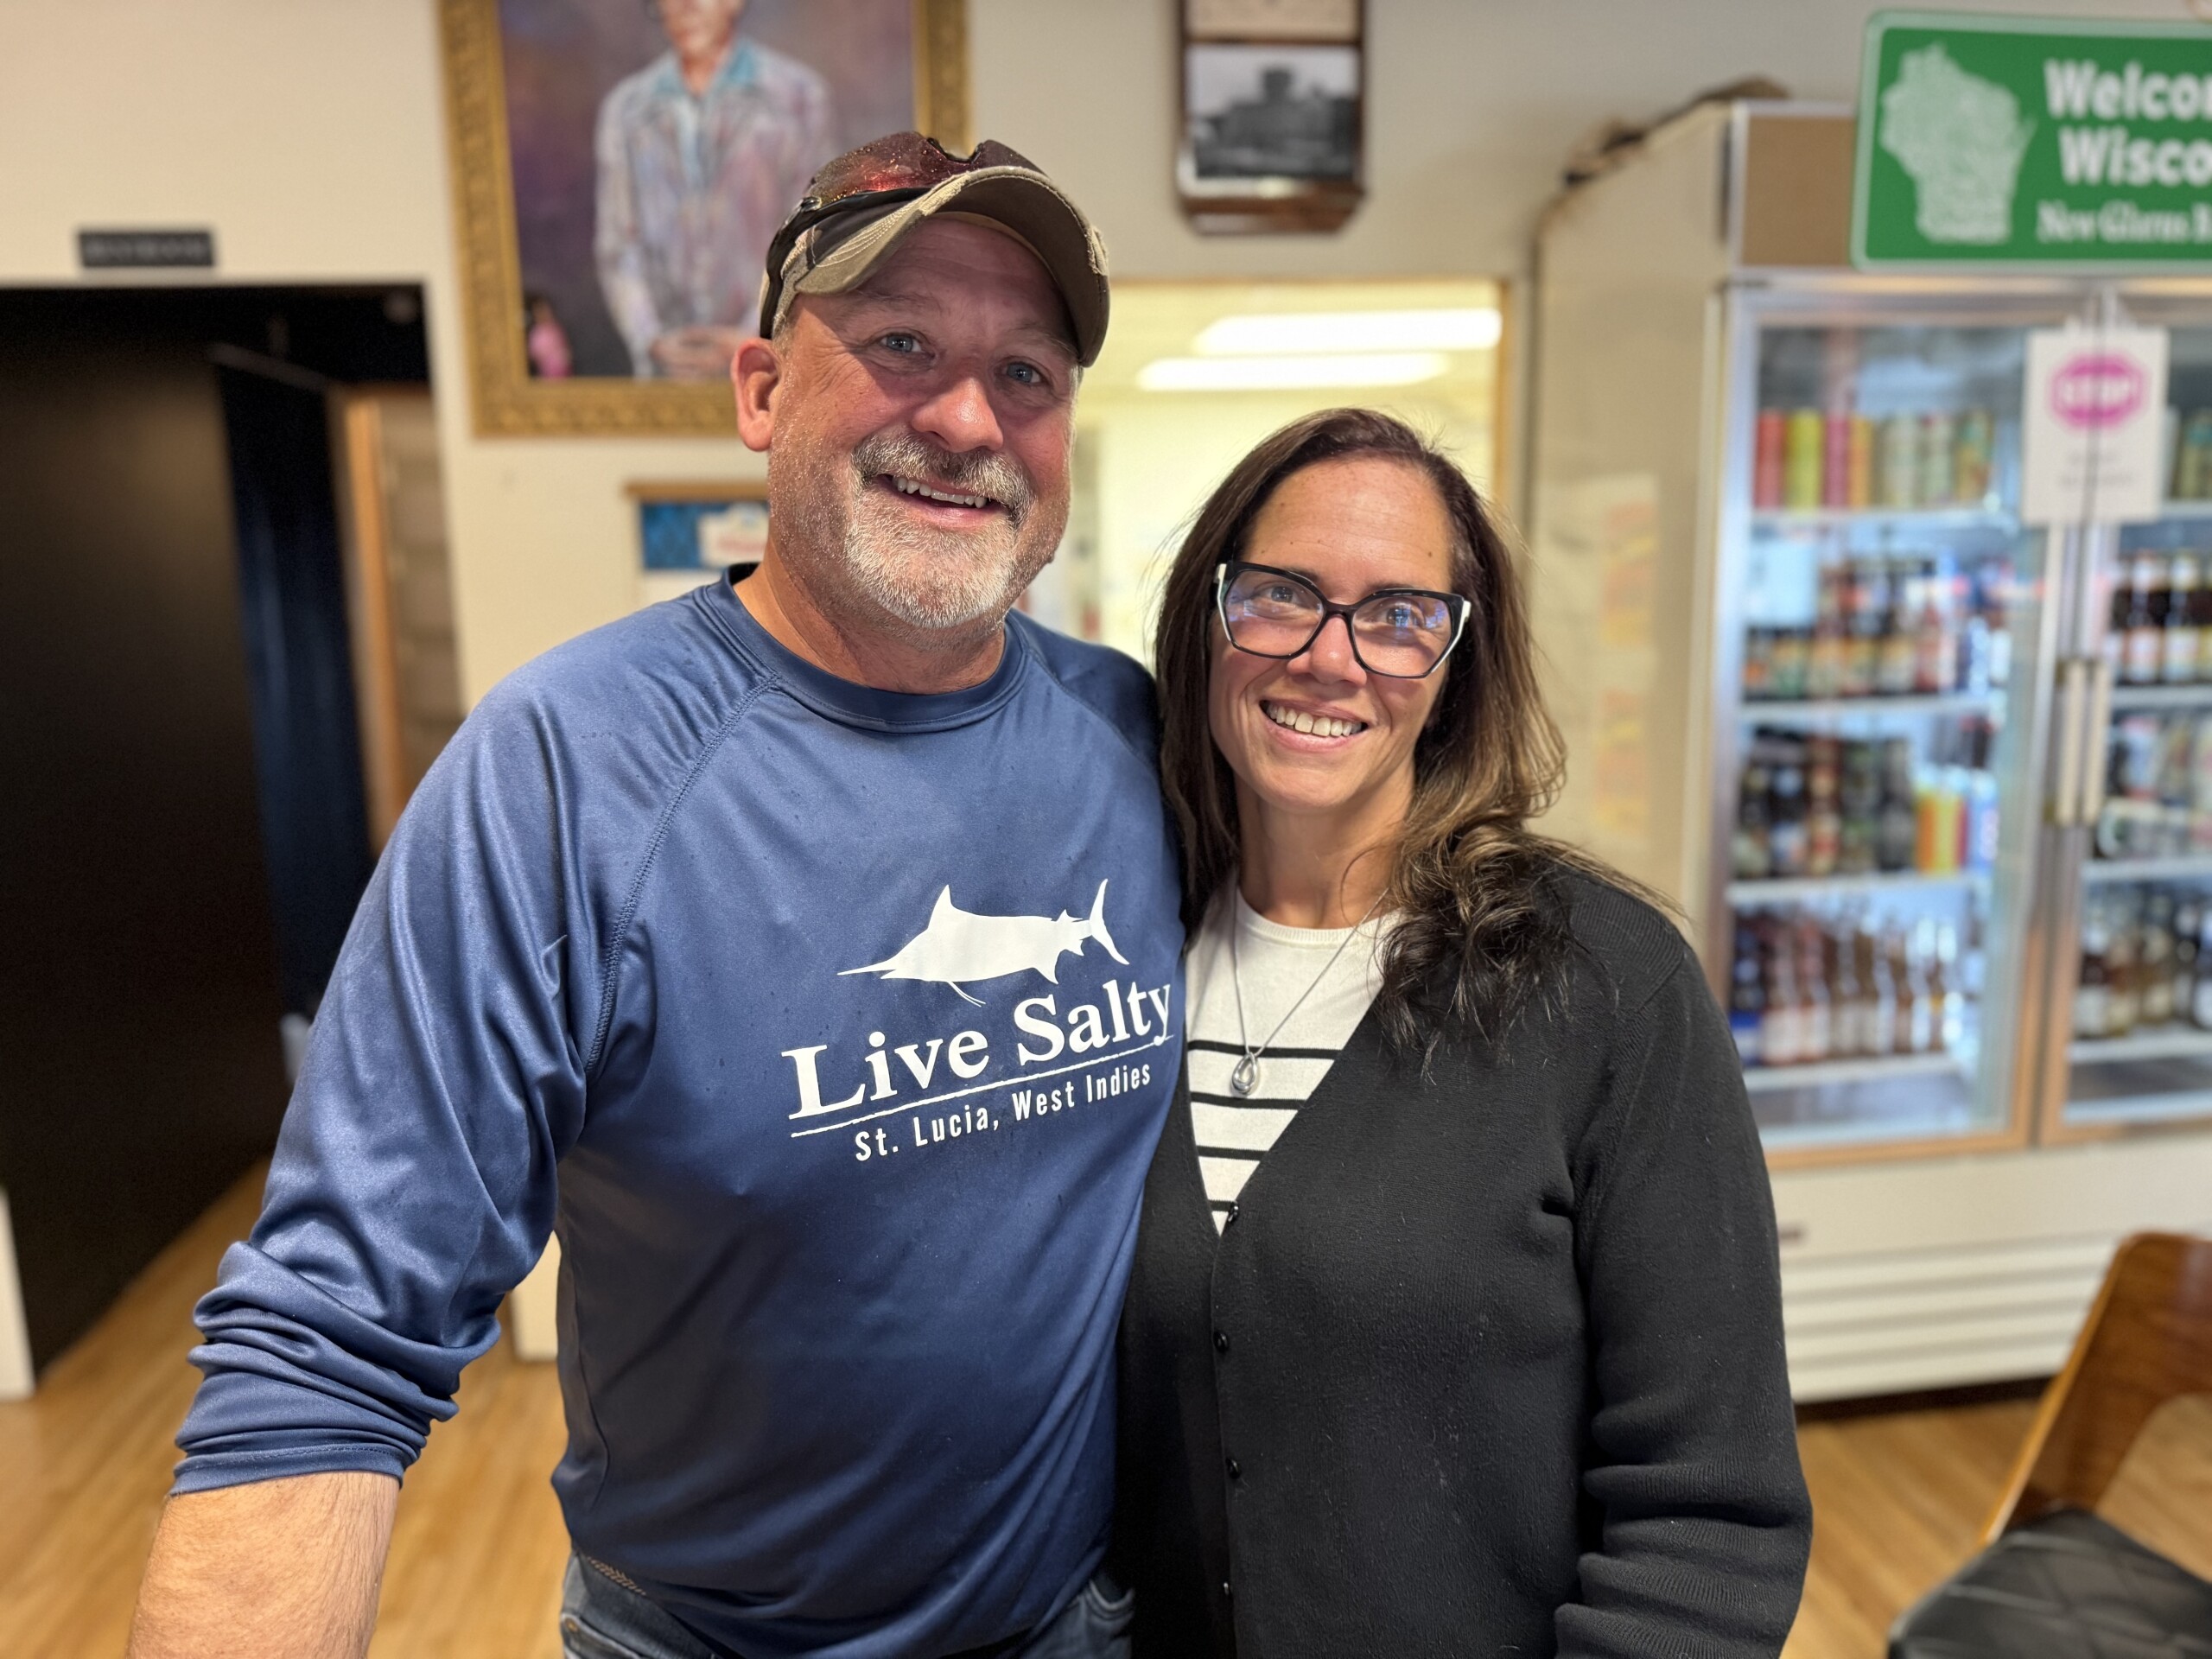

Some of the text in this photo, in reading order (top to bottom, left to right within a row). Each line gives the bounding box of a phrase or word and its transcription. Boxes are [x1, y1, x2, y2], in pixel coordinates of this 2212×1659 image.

[2037, 200, 2095, 244] New
[781, 978, 1173, 1120] Live Salty
[855, 1064, 1152, 1161] St. Lucia, West Indies
